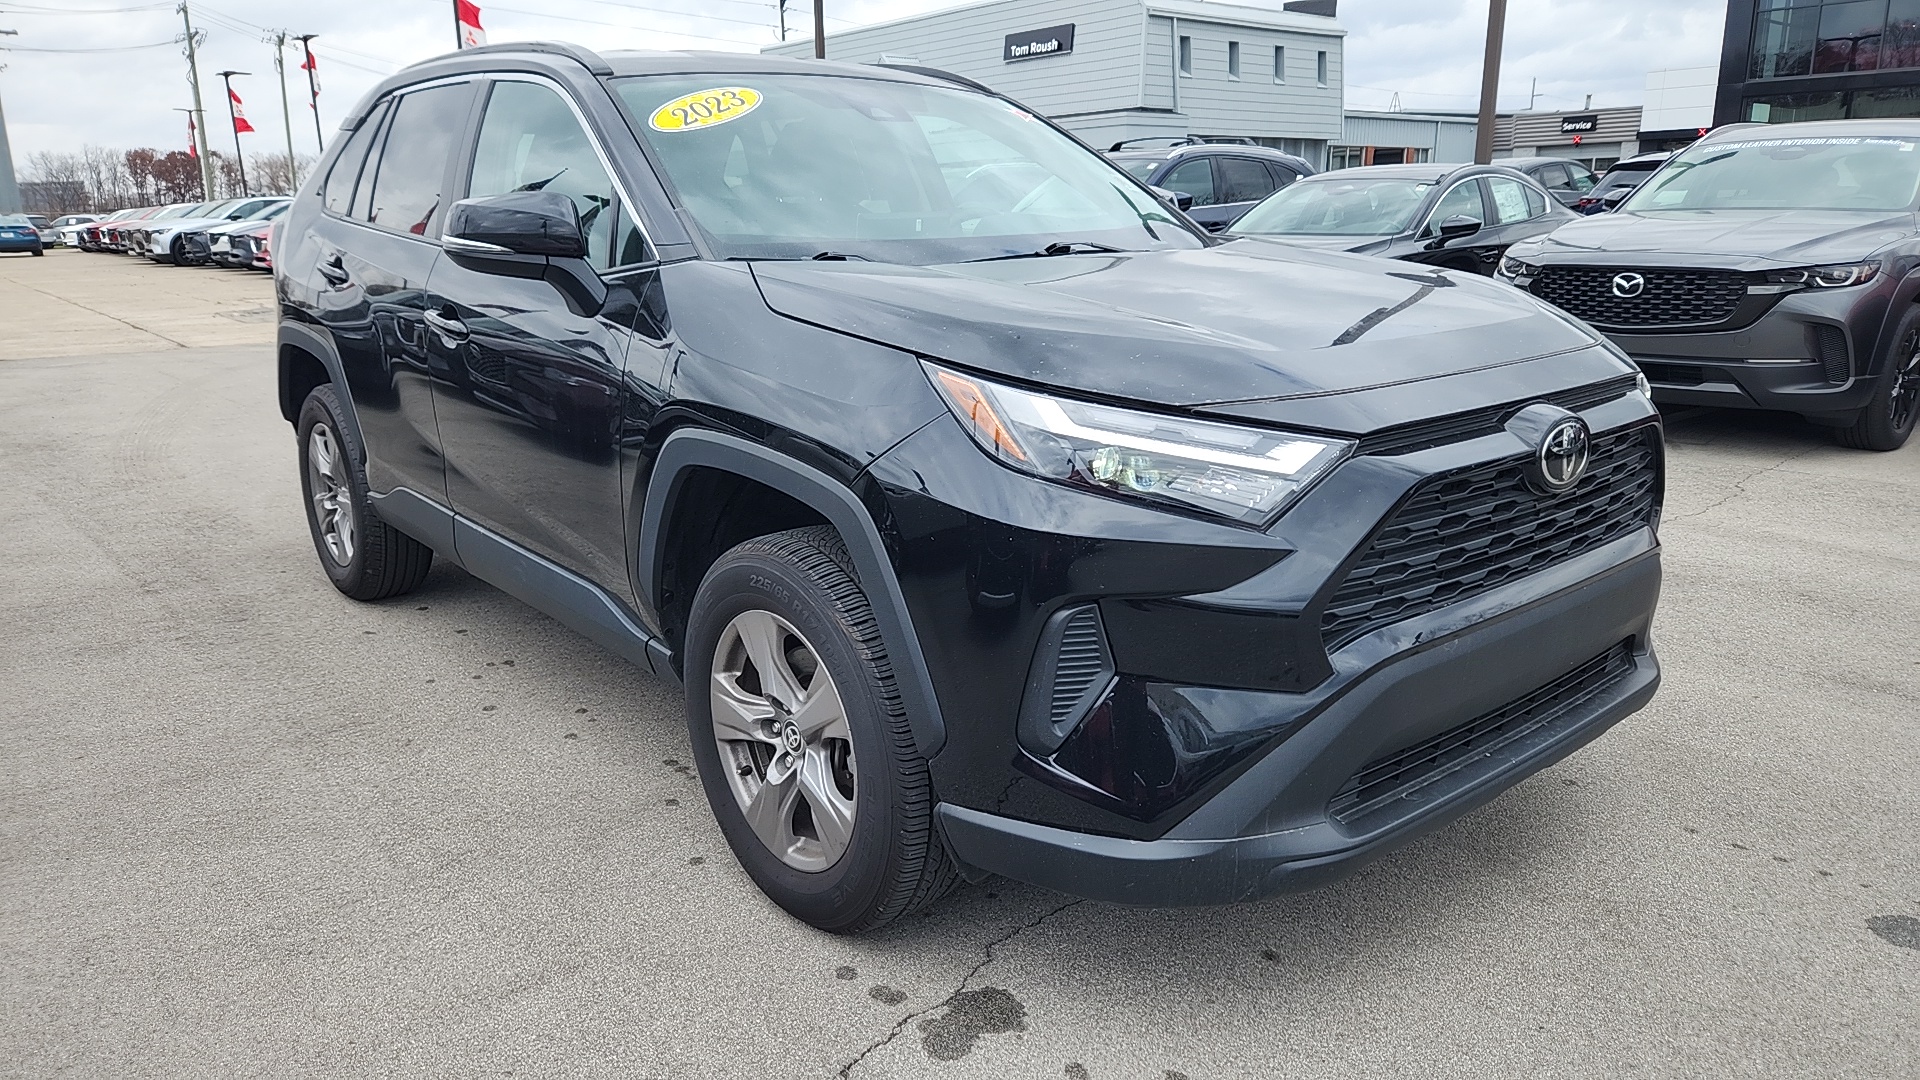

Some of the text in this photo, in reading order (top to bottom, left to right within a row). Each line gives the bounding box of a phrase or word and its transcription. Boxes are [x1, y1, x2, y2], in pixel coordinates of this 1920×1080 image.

[1010, 38, 1059, 57] Tom Roush
[671, 90, 746, 127] 2023
[1562, 120, 1593, 131] Service
[1703, 141, 1741, 153] CUSTOM
[1741, 139, 1782, 149] LEATHER
[1781, 138, 1825, 146] INTERIOR
[1826, 137, 1862, 145] INSIDE
[749, 573, 792, 604] 225/65
